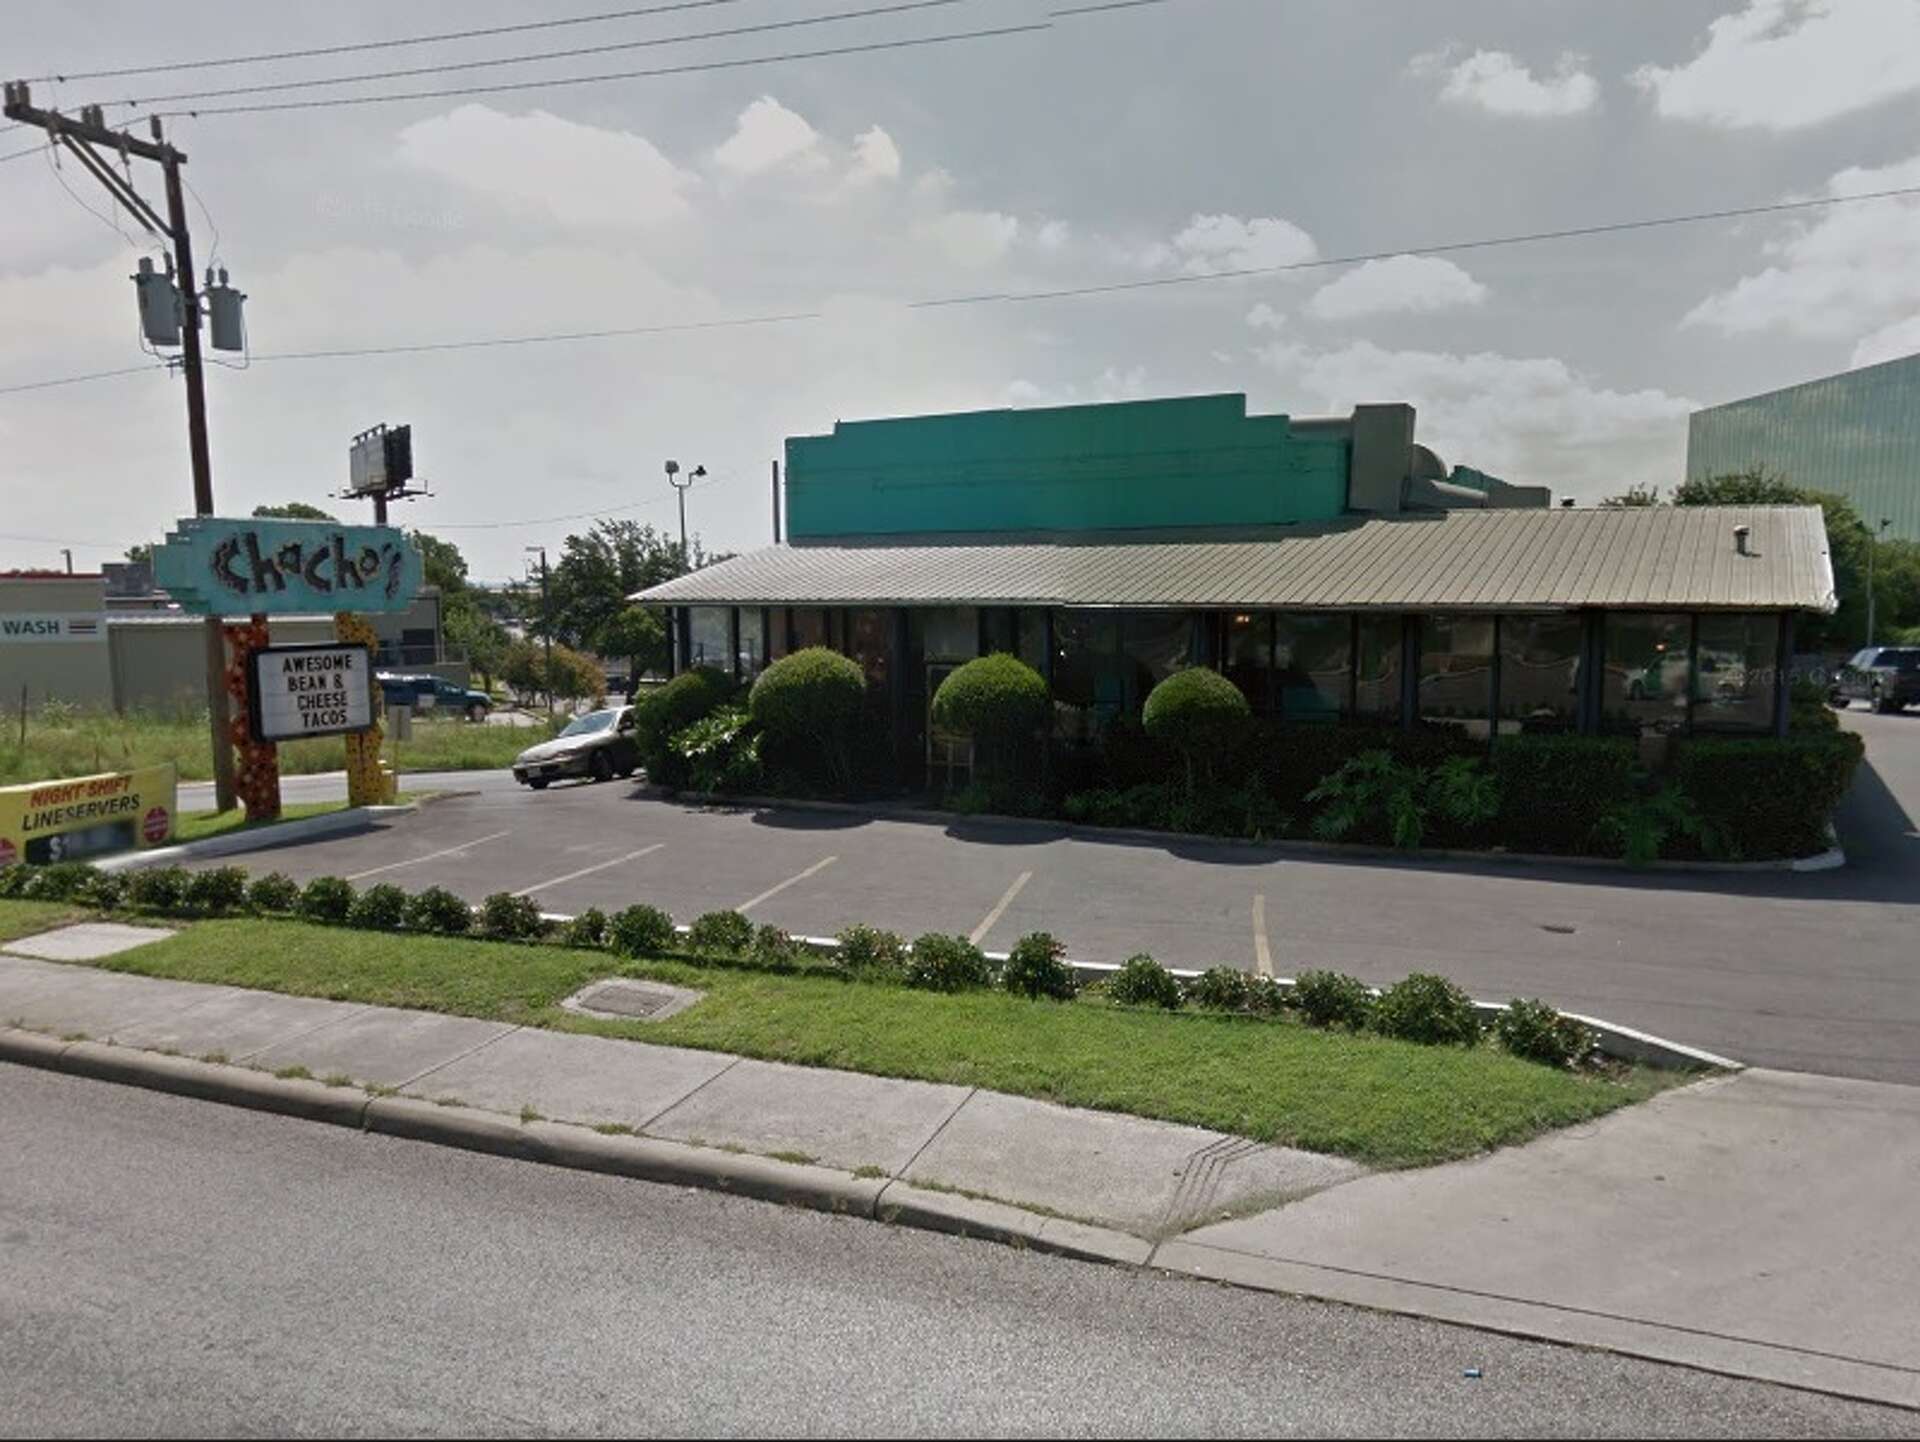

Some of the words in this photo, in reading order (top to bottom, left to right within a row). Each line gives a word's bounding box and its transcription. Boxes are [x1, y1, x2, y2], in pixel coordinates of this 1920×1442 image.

[2, 620, 60, 635] WASH
[282, 654, 352, 673] AWESOME
[287, 674, 327, 692] BEAN
[333, 673, 344, 689] &
[297, 691, 348, 711] CHEESE
[302, 710, 347, 728] TACOS
[30, 783, 84, 808] NIGHT
[87, 775, 133, 797] SHIFT
[22, 794, 141, 831] LINESERVERS
